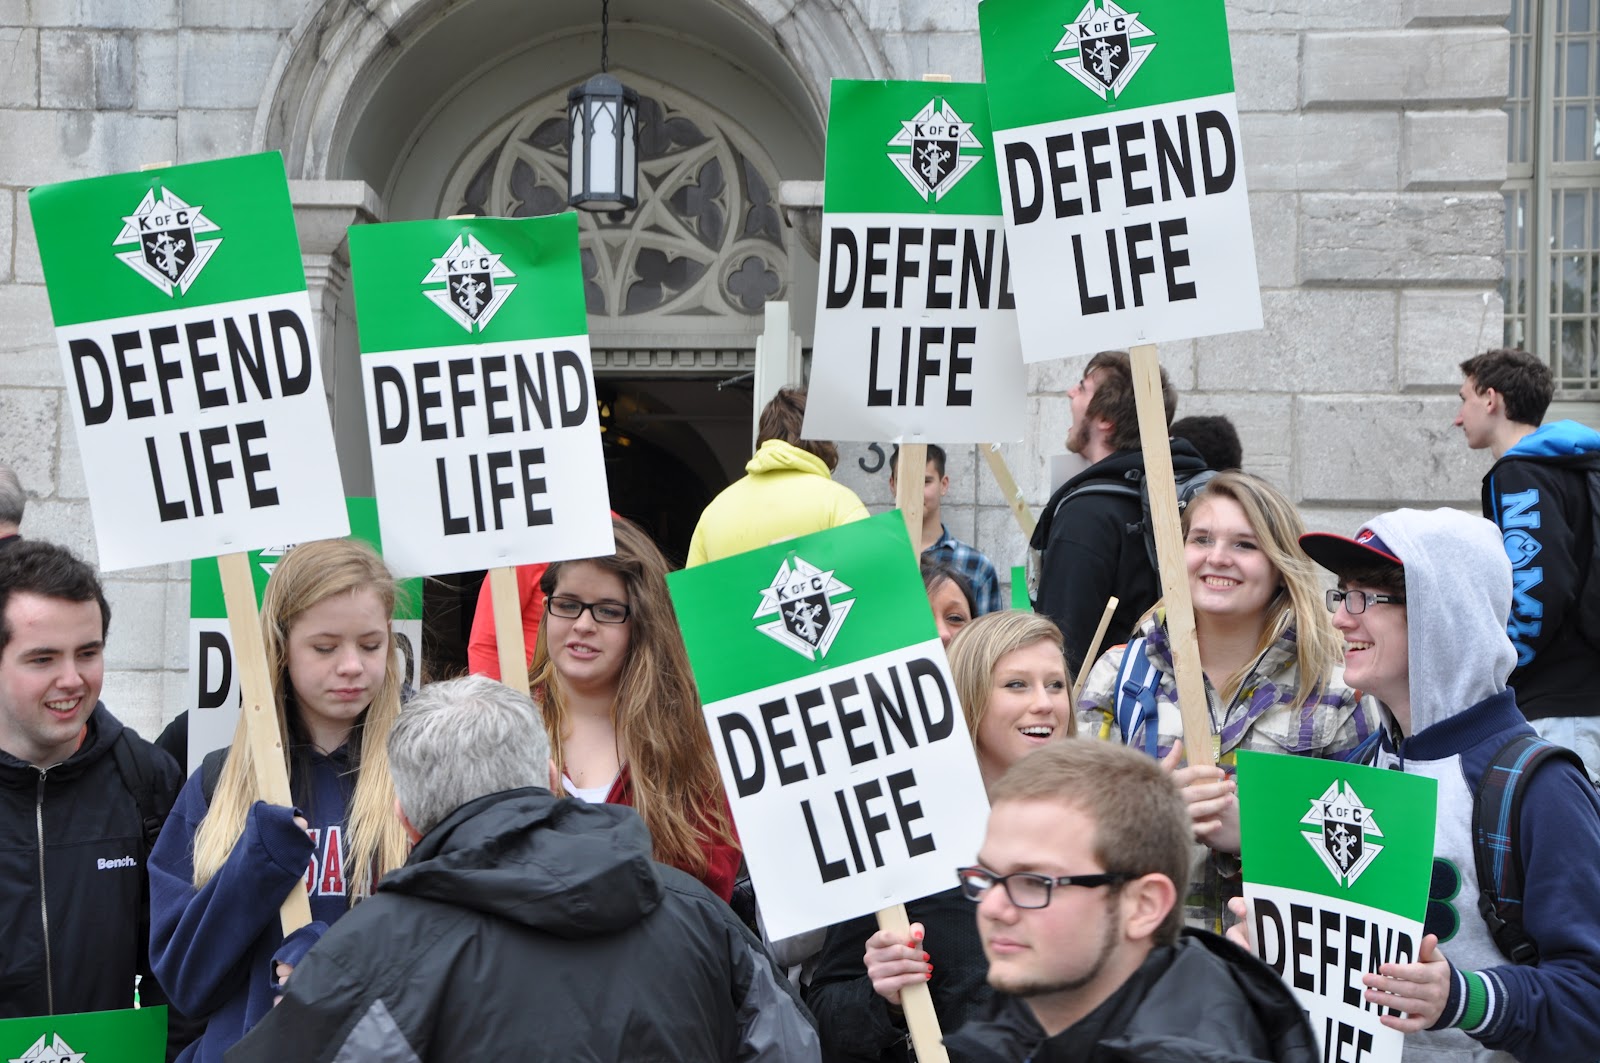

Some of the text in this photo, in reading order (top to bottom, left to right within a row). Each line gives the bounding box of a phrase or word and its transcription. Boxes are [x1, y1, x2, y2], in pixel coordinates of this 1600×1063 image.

[1079, 22, 1091, 38] K
[1114, 17, 1125, 32] C
[914, 123, 925, 137] K
[948, 125, 959, 138] C
[1004, 110, 1236, 226] DEFEND
[138, 216, 152, 231] K
[176, 211, 189, 225] C
[447, 259, 457, 272] K
[479, 257, 489, 270] C
[1072, 217, 1197, 316] LIFE
[69, 308, 312, 426] DEFEND
[372, 350, 589, 446] DEFEND
[867, 326, 977, 407] LIFE
[145, 419, 280, 523] LIFE
[436, 447, 553, 536] LIFE
[776, 586, 790, 601] K
[811, 576, 822, 591] C
[717, 657, 954, 799] DEFEND
[800, 768, 936, 884] LIFE
[1323, 803, 1333, 818] K
[1353, 808, 1362, 823] C
[97, 855, 137, 870] Bench.
